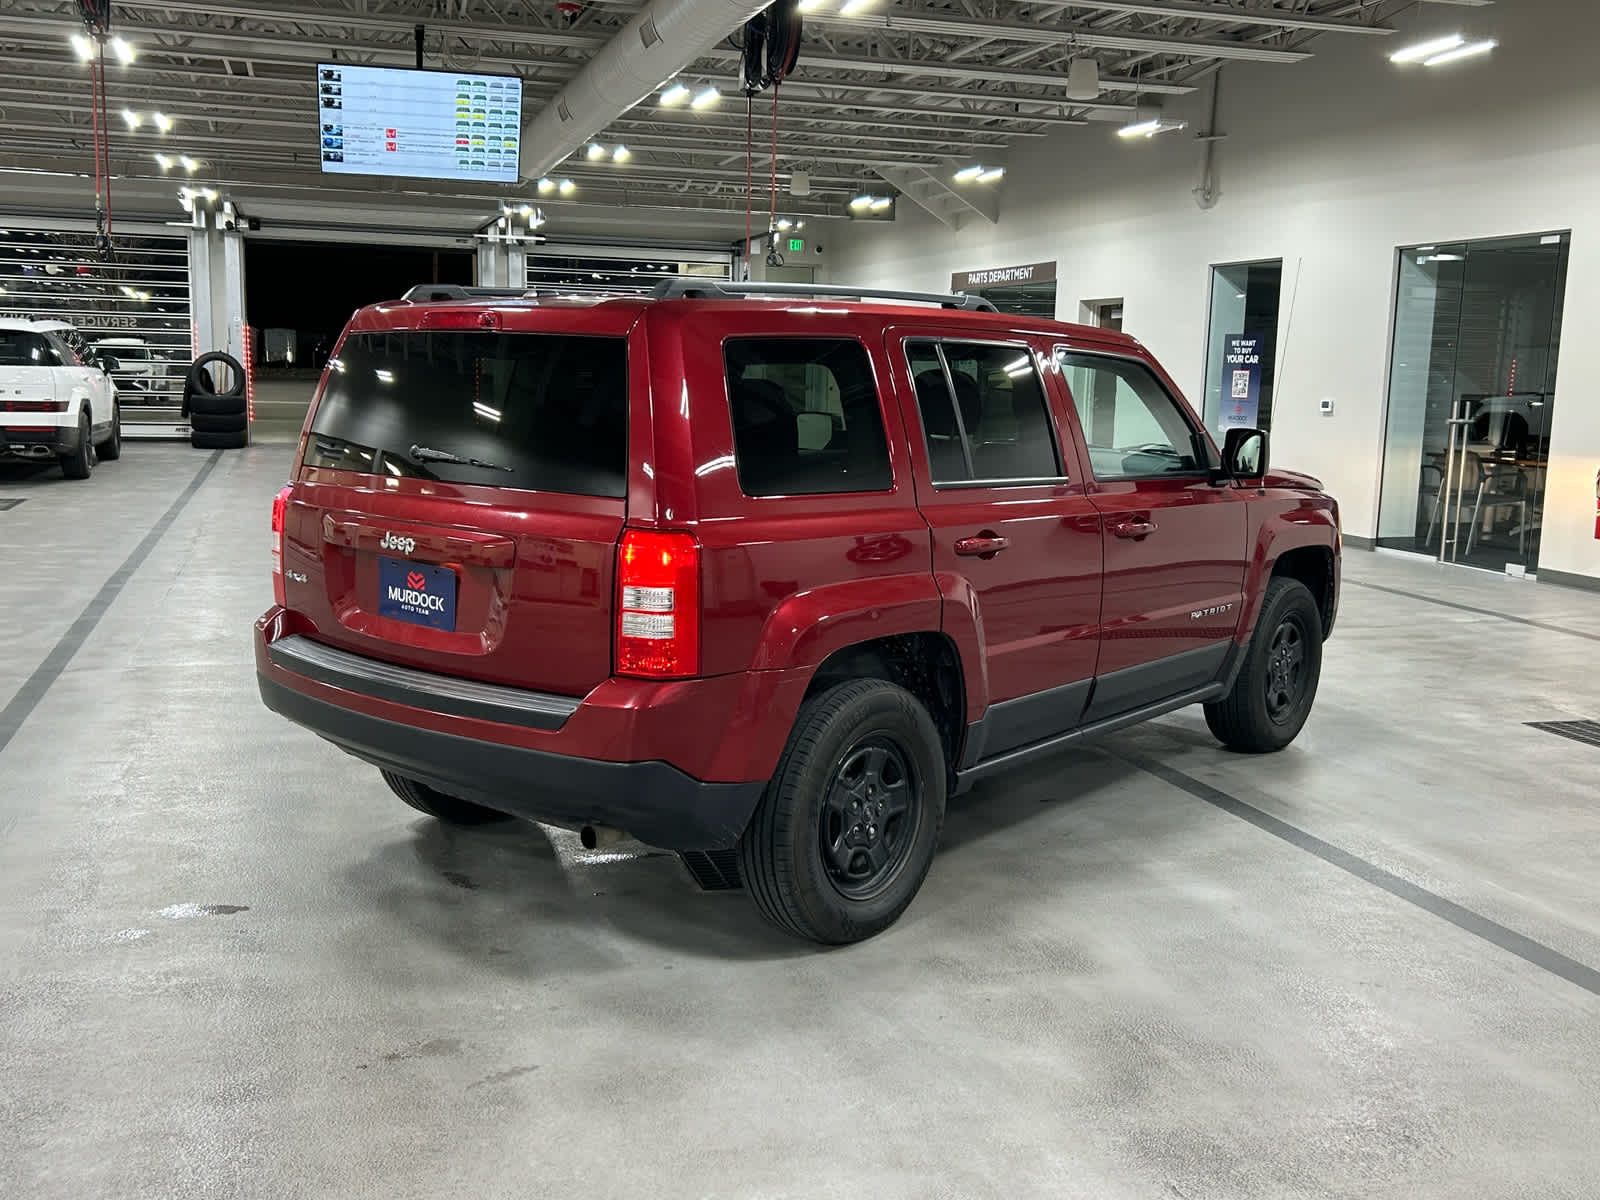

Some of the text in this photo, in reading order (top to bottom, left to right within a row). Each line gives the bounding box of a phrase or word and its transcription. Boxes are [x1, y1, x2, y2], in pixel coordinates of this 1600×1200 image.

[968, 266, 1034, 285] PARTS DEPARTMENT
[1226, 354, 1259, 364] YOUR CAR
[380, 531, 416, 555] Jeep
[388, 585, 444, 612] MURDOCK
[401, 604, 429, 616] AUTO TEAM
[1190, 603, 1233, 620] PATRIOT
